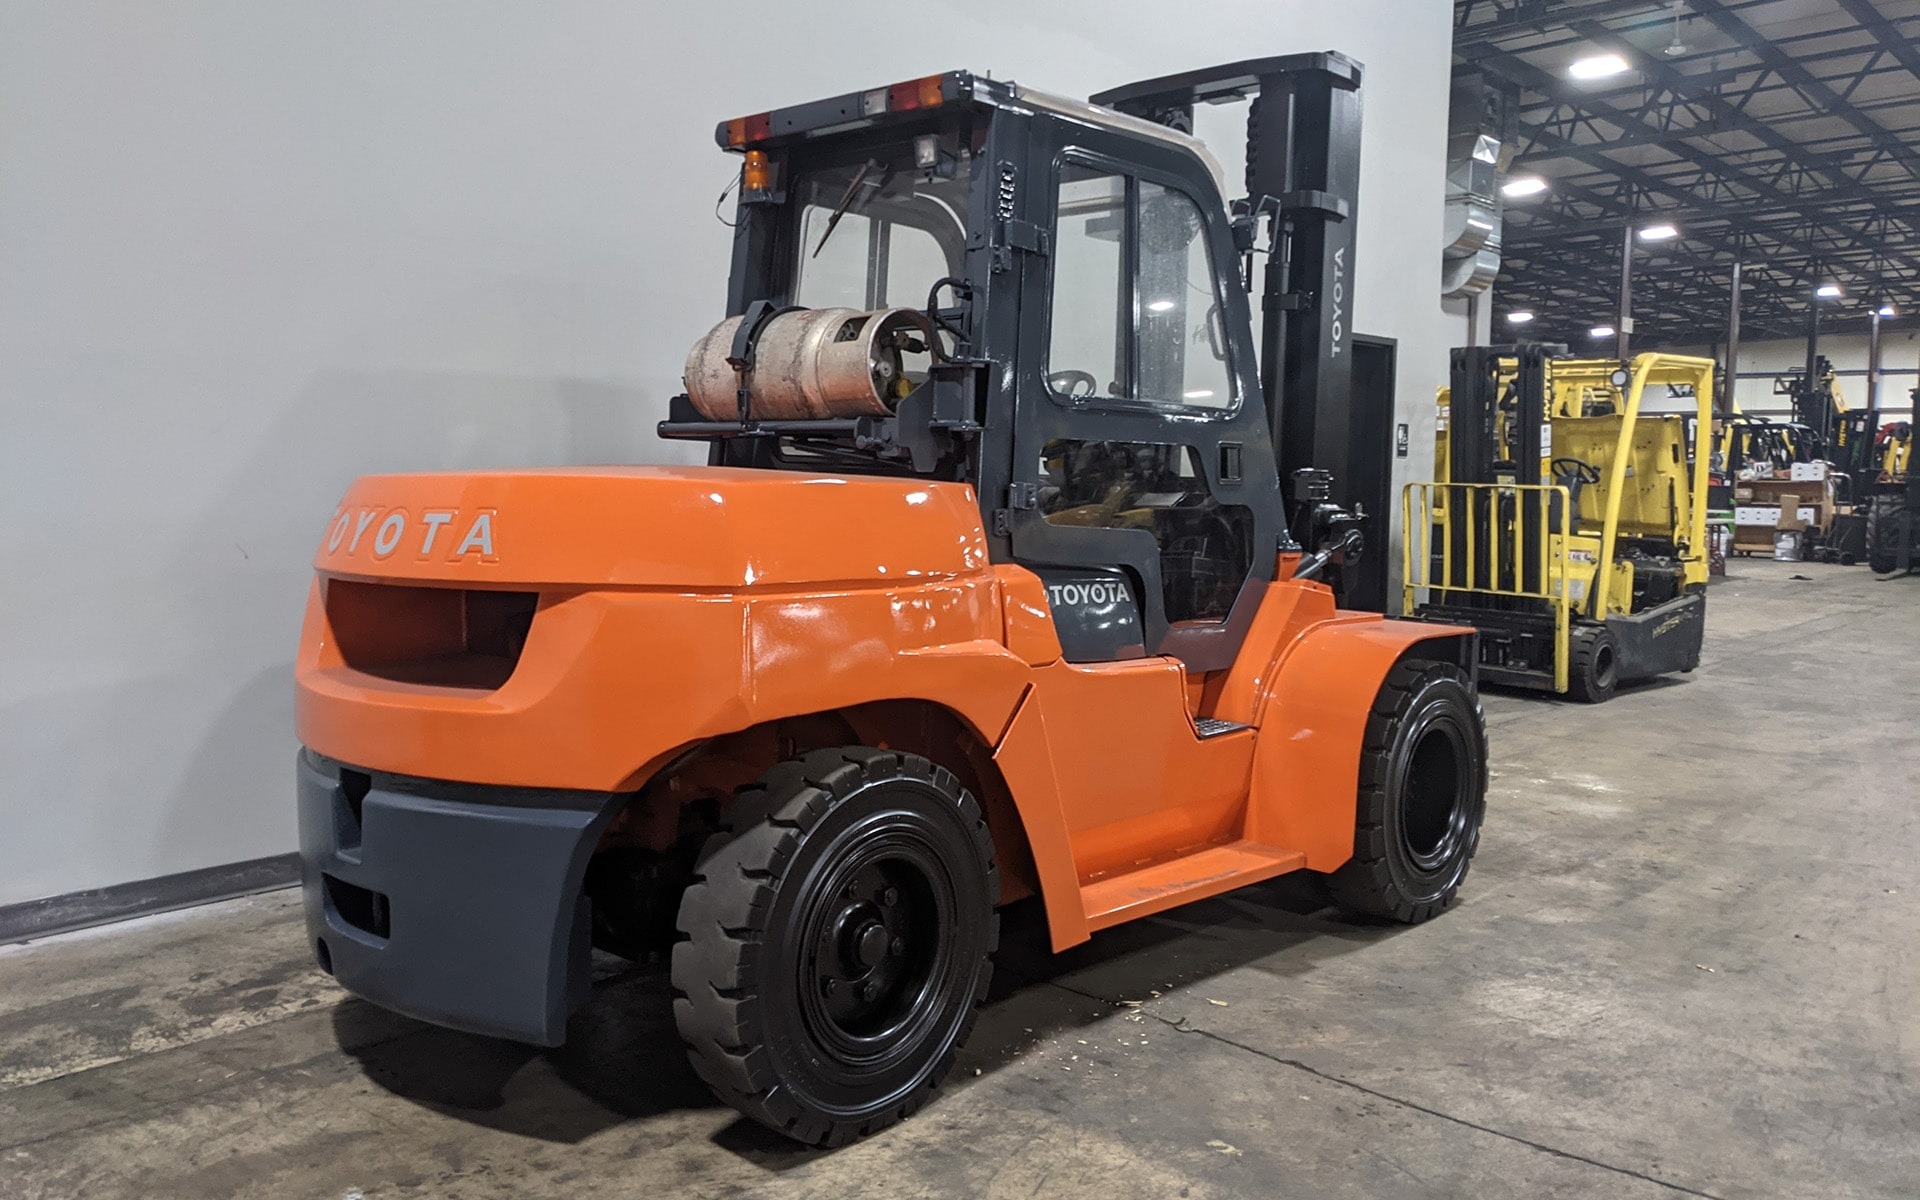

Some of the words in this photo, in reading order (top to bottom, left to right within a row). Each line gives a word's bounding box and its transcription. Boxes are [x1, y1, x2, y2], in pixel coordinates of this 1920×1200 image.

[1331, 247, 1345, 358] TOYOTA
[1543, 358, 1551, 421] HYSTER
[328, 509, 495, 556] OYOTA
[1049, 583, 1130, 606] TOYOTA
